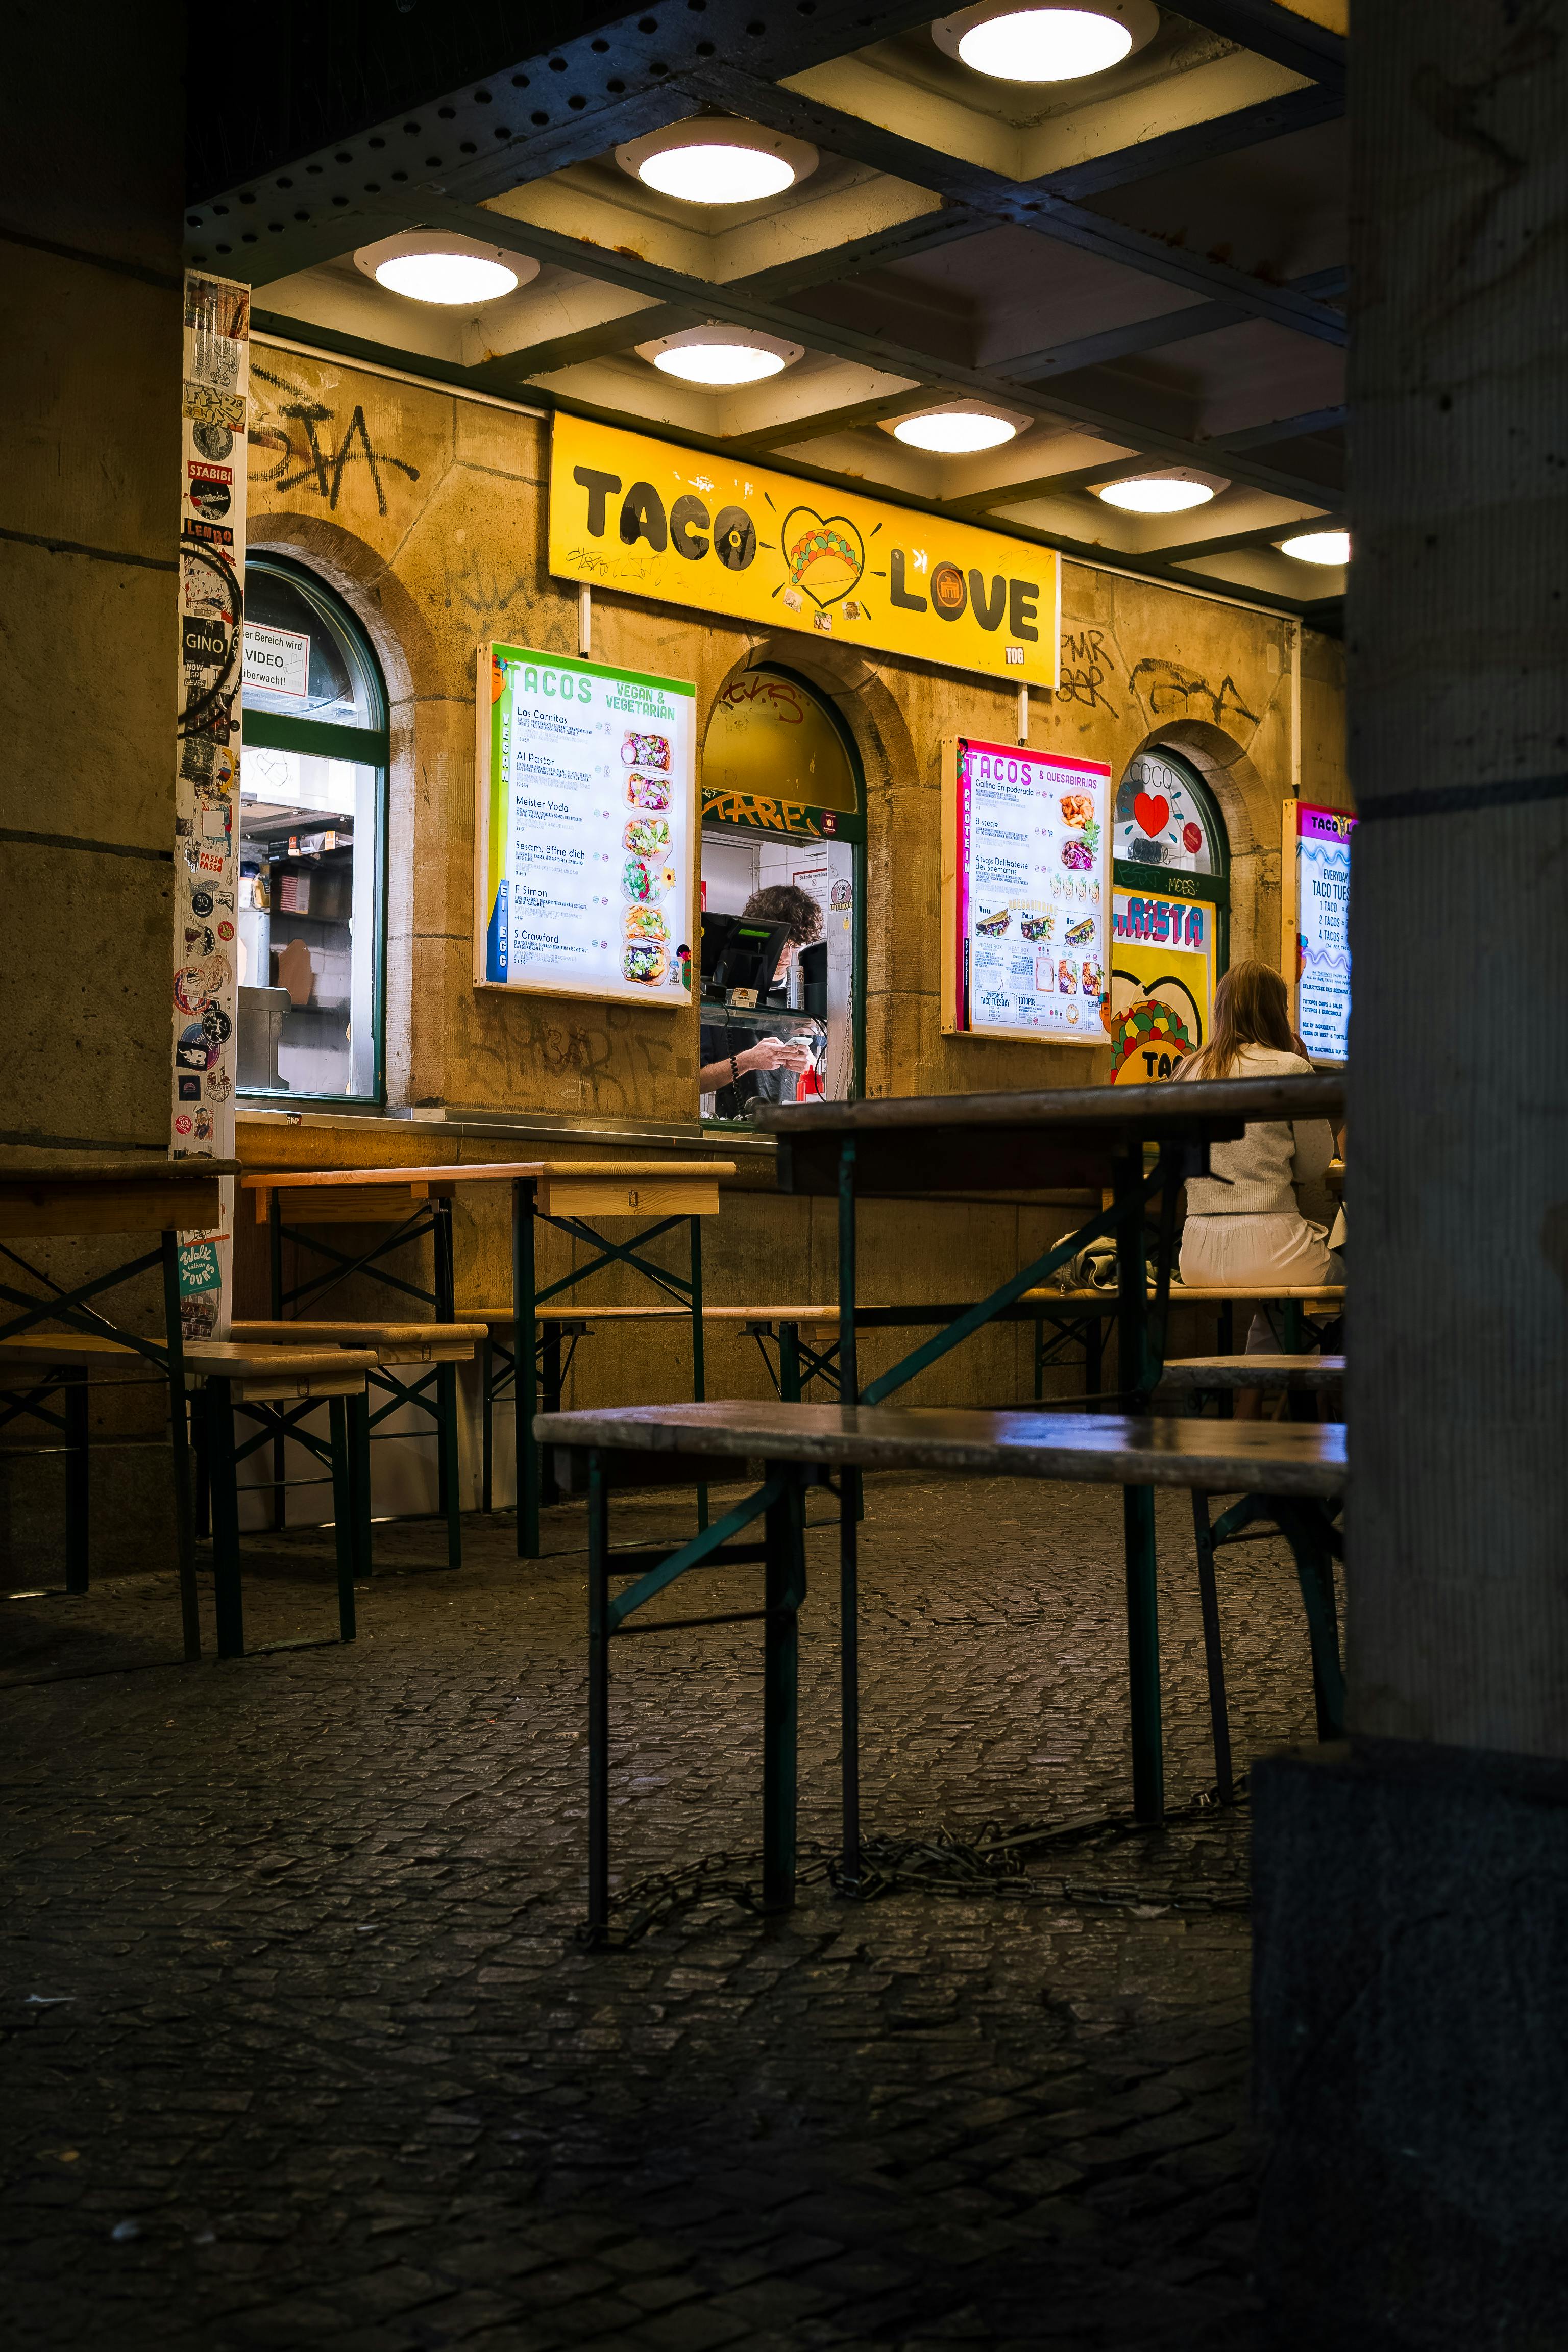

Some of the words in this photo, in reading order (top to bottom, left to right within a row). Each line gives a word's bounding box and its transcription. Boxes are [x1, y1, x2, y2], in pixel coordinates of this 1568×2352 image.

[190, 465, 231, 481] STABIBI
[573, 465, 756, 571] TACO
[891, 548, 1039, 642] LOVE
[186, 634, 223, 653] GINO
[255, 631, 283, 647] Bereich
[286, 641, 302, 651] wird
[245, 649, 284, 668] VIDEO
[1006, 648, 1024, 664] TOG
[507, 663, 592, 703] TACOS
[617, 682, 653, 702] VEGAN
[657, 692, 665, 704] &
[518, 706, 531, 717] Las
[534, 710, 568, 724] Carnitas
[606, 695, 675, 721] VEGETARIAN
[502, 713, 510, 783] VEGAN
[517, 751, 525, 761] Al
[529, 753, 554, 766] Pastor
[966, 753, 1031, 786] TACOS
[1039, 770, 1044, 780] &
[1047, 771, 1097, 789] QUESABIRRIAS
[1130, 762, 1172, 789] COCO
[975, 779, 996, 790] Gallina
[997, 783, 1034, 796] Empoderada
[517, 796, 545, 808] Meister
[548, 801, 569, 812] Yoda
[982, 819, 998, 828] steak
[1311, 817, 1338, 832] TACO
[516, 841, 543, 853] Sesam,
[547, 845, 566, 856] öffne
[569, 849, 585, 859] dich
[975, 862, 985, 870] des
[988, 864, 1017, 875] Seemanns
[995, 857, 1028, 869] Delikatesse
[1324, 869, 1348, 884] EVERYDAY
[515, 885, 520, 893] F
[523, 886, 547, 897] Simon
[1313, 880, 1331, 898] TACO
[1325, 901, 1337, 913] TACO
[1319, 915, 1322, 925] 2
[1324, 915, 1340, 927] TACOS
[514, 929, 519, 938] S
[522, 930, 559, 943] Crawford
[1319, 929, 1322, 940] 4
[1324, 930, 1340, 942] TACOS
[981, 996, 991, 1006] TACO
[992, 998, 1010, 1007] TUESDAY
[1018, 997, 1036, 1006] TOTOPOS
[180, 1244, 211, 1266] Walk
[182, 1263, 214, 1285] TOURS
